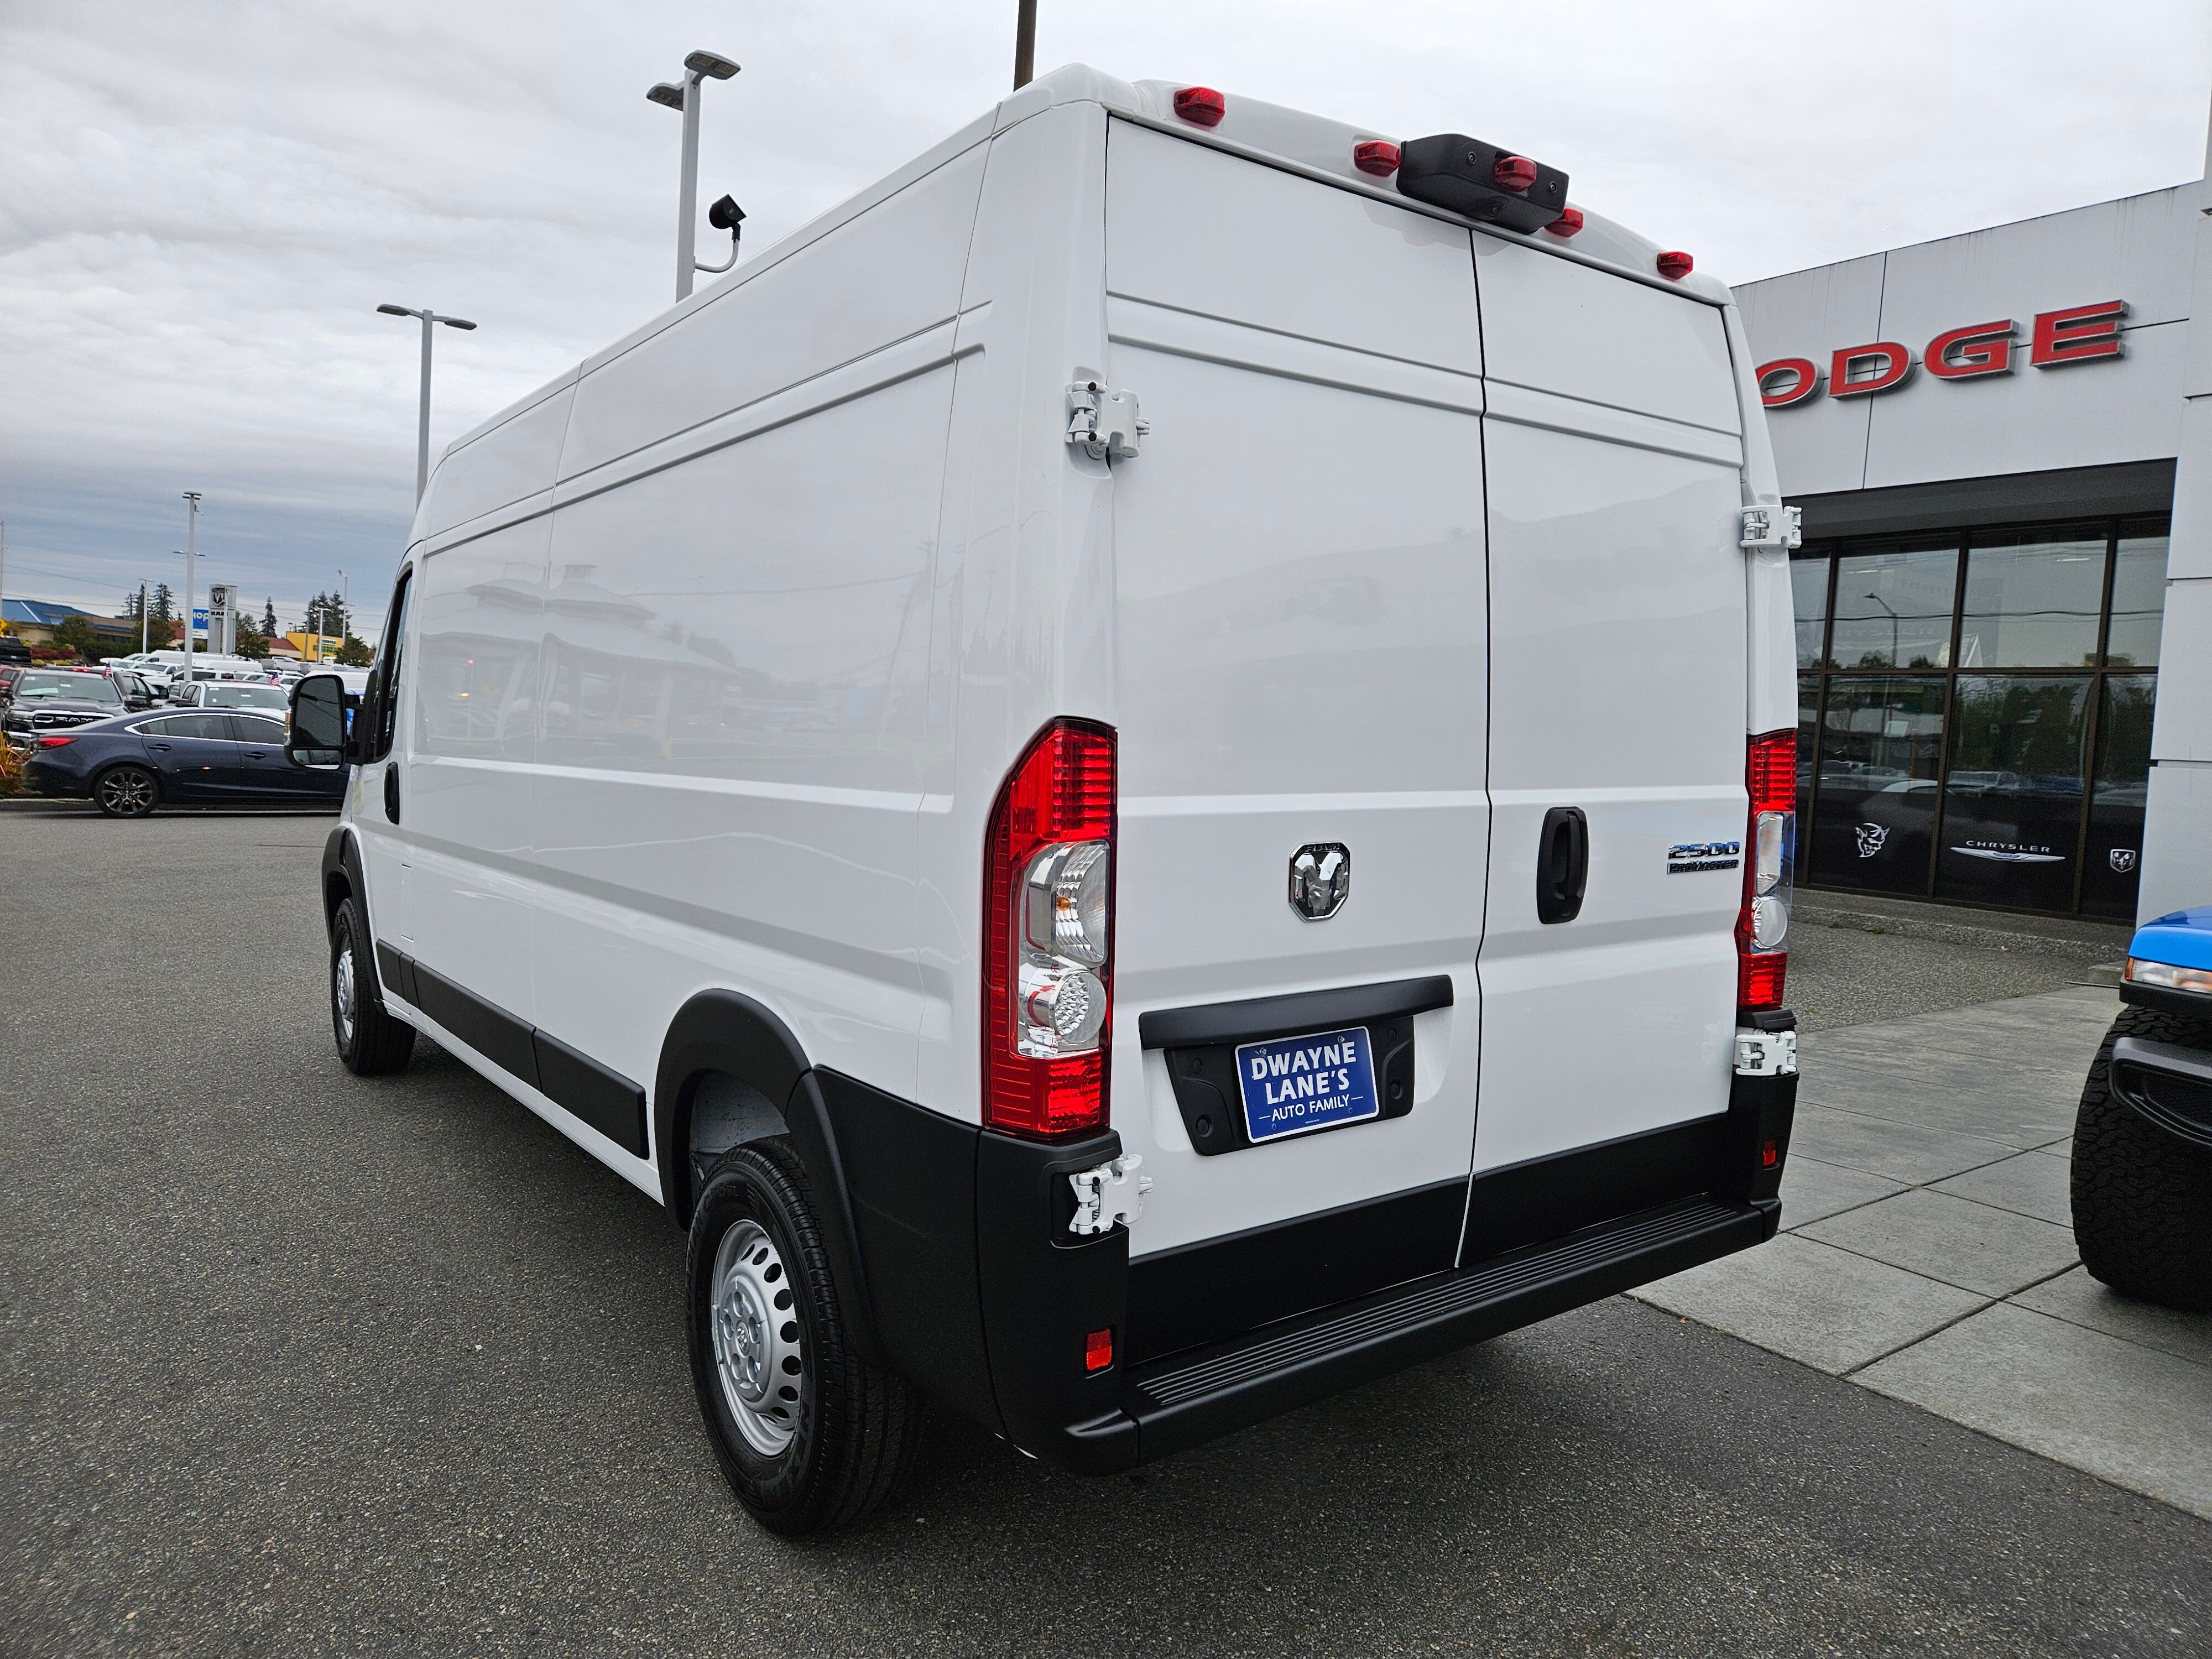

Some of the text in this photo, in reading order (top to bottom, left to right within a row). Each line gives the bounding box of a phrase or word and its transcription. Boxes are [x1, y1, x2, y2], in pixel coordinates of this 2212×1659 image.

[1755, 299, 2130, 408] ODGE
[1305, 843, 1340, 852] RAM
[1668, 841, 1740, 859] 2500
[1966, 840, 2050, 853] CHRYSLER
[1251, 1041, 1357, 1080] DWAYNE
[1265, 1068, 1350, 1105] LANE'S
[1272, 1094, 1350, 1121] AUTO FAMILY
